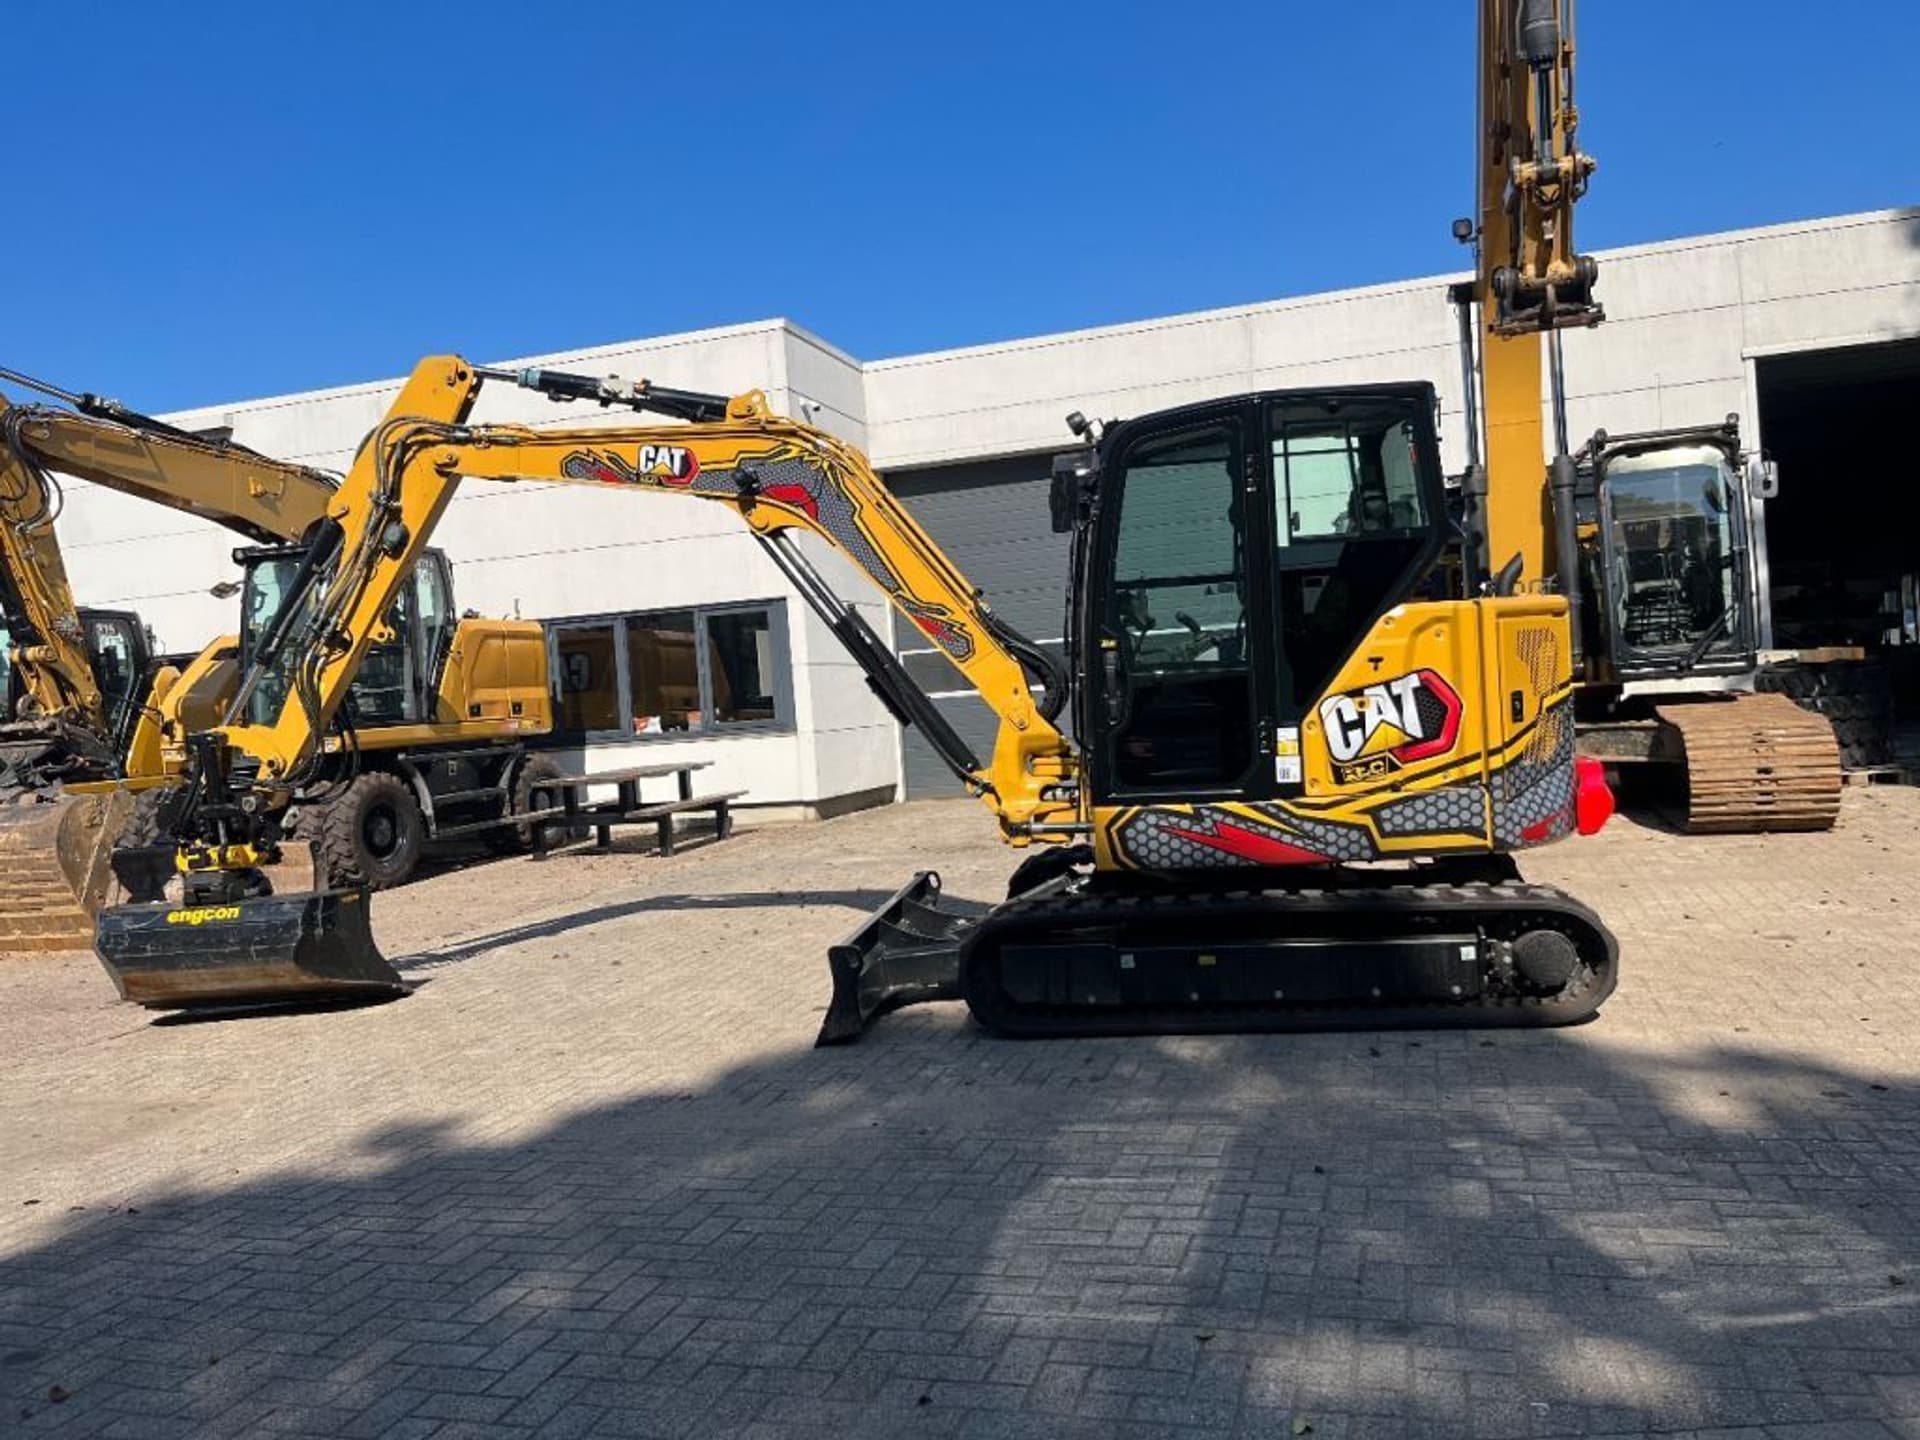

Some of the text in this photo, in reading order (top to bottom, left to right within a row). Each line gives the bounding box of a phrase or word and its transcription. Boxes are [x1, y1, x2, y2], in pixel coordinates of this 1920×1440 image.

[640, 445, 686, 475] CAT
[1320, 673, 1424, 761] CAT
[166, 906, 241, 925] engcon
